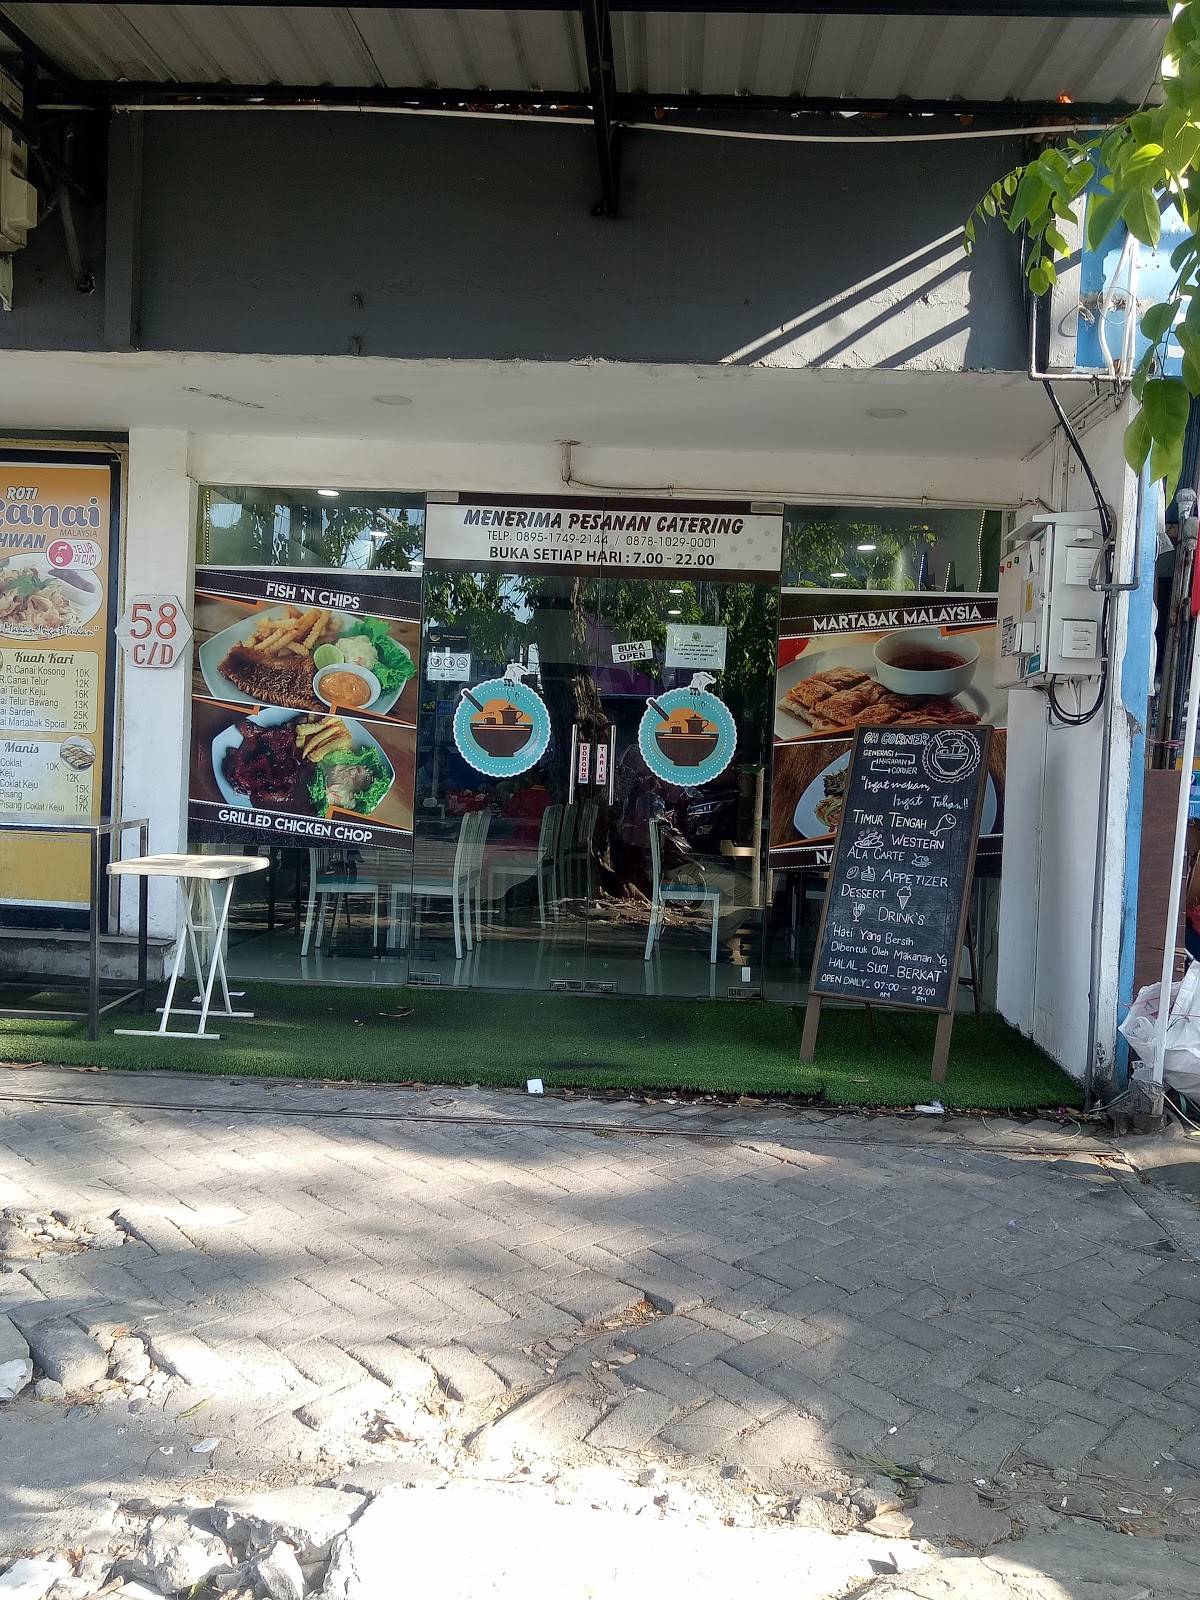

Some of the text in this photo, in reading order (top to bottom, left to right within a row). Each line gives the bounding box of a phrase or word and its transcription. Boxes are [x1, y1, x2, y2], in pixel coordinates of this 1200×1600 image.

[7, 486, 39, 501] ROTI
[463, 509, 744, 535] MENERIMA PESANAN CATERING
[60, 529, 98, 539] MALAYSIA
[487, 530, 512, 541] TELP.
[516, 531, 609, 544] 0895-1749-2144
[626, 535, 717, 549] 0878-1029-0001
[489, 547, 530, 560] BUKA
[533, 549, 583, 562] SETIAP
[586, 551, 622, 563] HARI
[633, 552, 664, 564] 7.00
[675, 554, 715, 566] 22.00
[266, 582, 297, 600] FISH
[318, 591, 360, 610] CHIPS
[130, 603, 177, 639] 58
[813, 605, 982, 632] MARTABAK MALAYSIA
[133, 641, 174, 665] C/D
[618, 643, 645, 653] BUKA
[14, 652, 74, 664] Kuah Kari
[619, 652, 646, 661] OPEN
[37, 666, 66, 678] Kosong
[75, 669, 90, 678] 10K
[31, 677, 49, 685] Telur
[75, 679, 90, 688] 12K
[9, 686, 28, 695] Telur
[29, 687, 46, 698] Keju
[75, 690, 89, 699] 16K
[9, 697, 28, 706] Telur
[29, 698, 59, 709] Bawang
[74, 701, 89, 710] 13K
[9, 707, 35, 716] Sarden
[73, 711, 89, 720] 25K
[9, 717, 43, 728] Martabak
[73, 721, 88, 730] 25K
[881, 732, 930, 745] CORNER
[4, 742, 40, 754] Manis
[46, 762, 60, 771] 10K
[891, 766, 918, 774] CORNER
[65, 774, 80, 783] 12K
[22, 780, 39, 791] Keju
[75, 785, 89, 794] 15K
[75, 795, 89, 804] 15K
[74, 804, 89, 813] 17K
[218, 809, 372, 843] GRILLED CHICKEN CHOP
[853, 810, 928, 829] TIMUR TENGAH
[891, 834, 945, 849] WESTERN
[846, 845, 906, 861] ALA CARTE
[881, 869, 948, 887] APPETIZER
[841, 883, 887, 899] DESSERT
[860, 930, 882, 943] Yang
[885, 932, 914, 946] Bersih
[831, 941, 948, 967] Dibentuk Oleh Makanan Yg
[828, 957, 858, 970] HALAL
[866, 961, 889, 975] SUCI
[821, 973, 842, 984] OPEN
[873, 981, 900, 992] 07:00
[911, 986, 936, 997] 22:00
